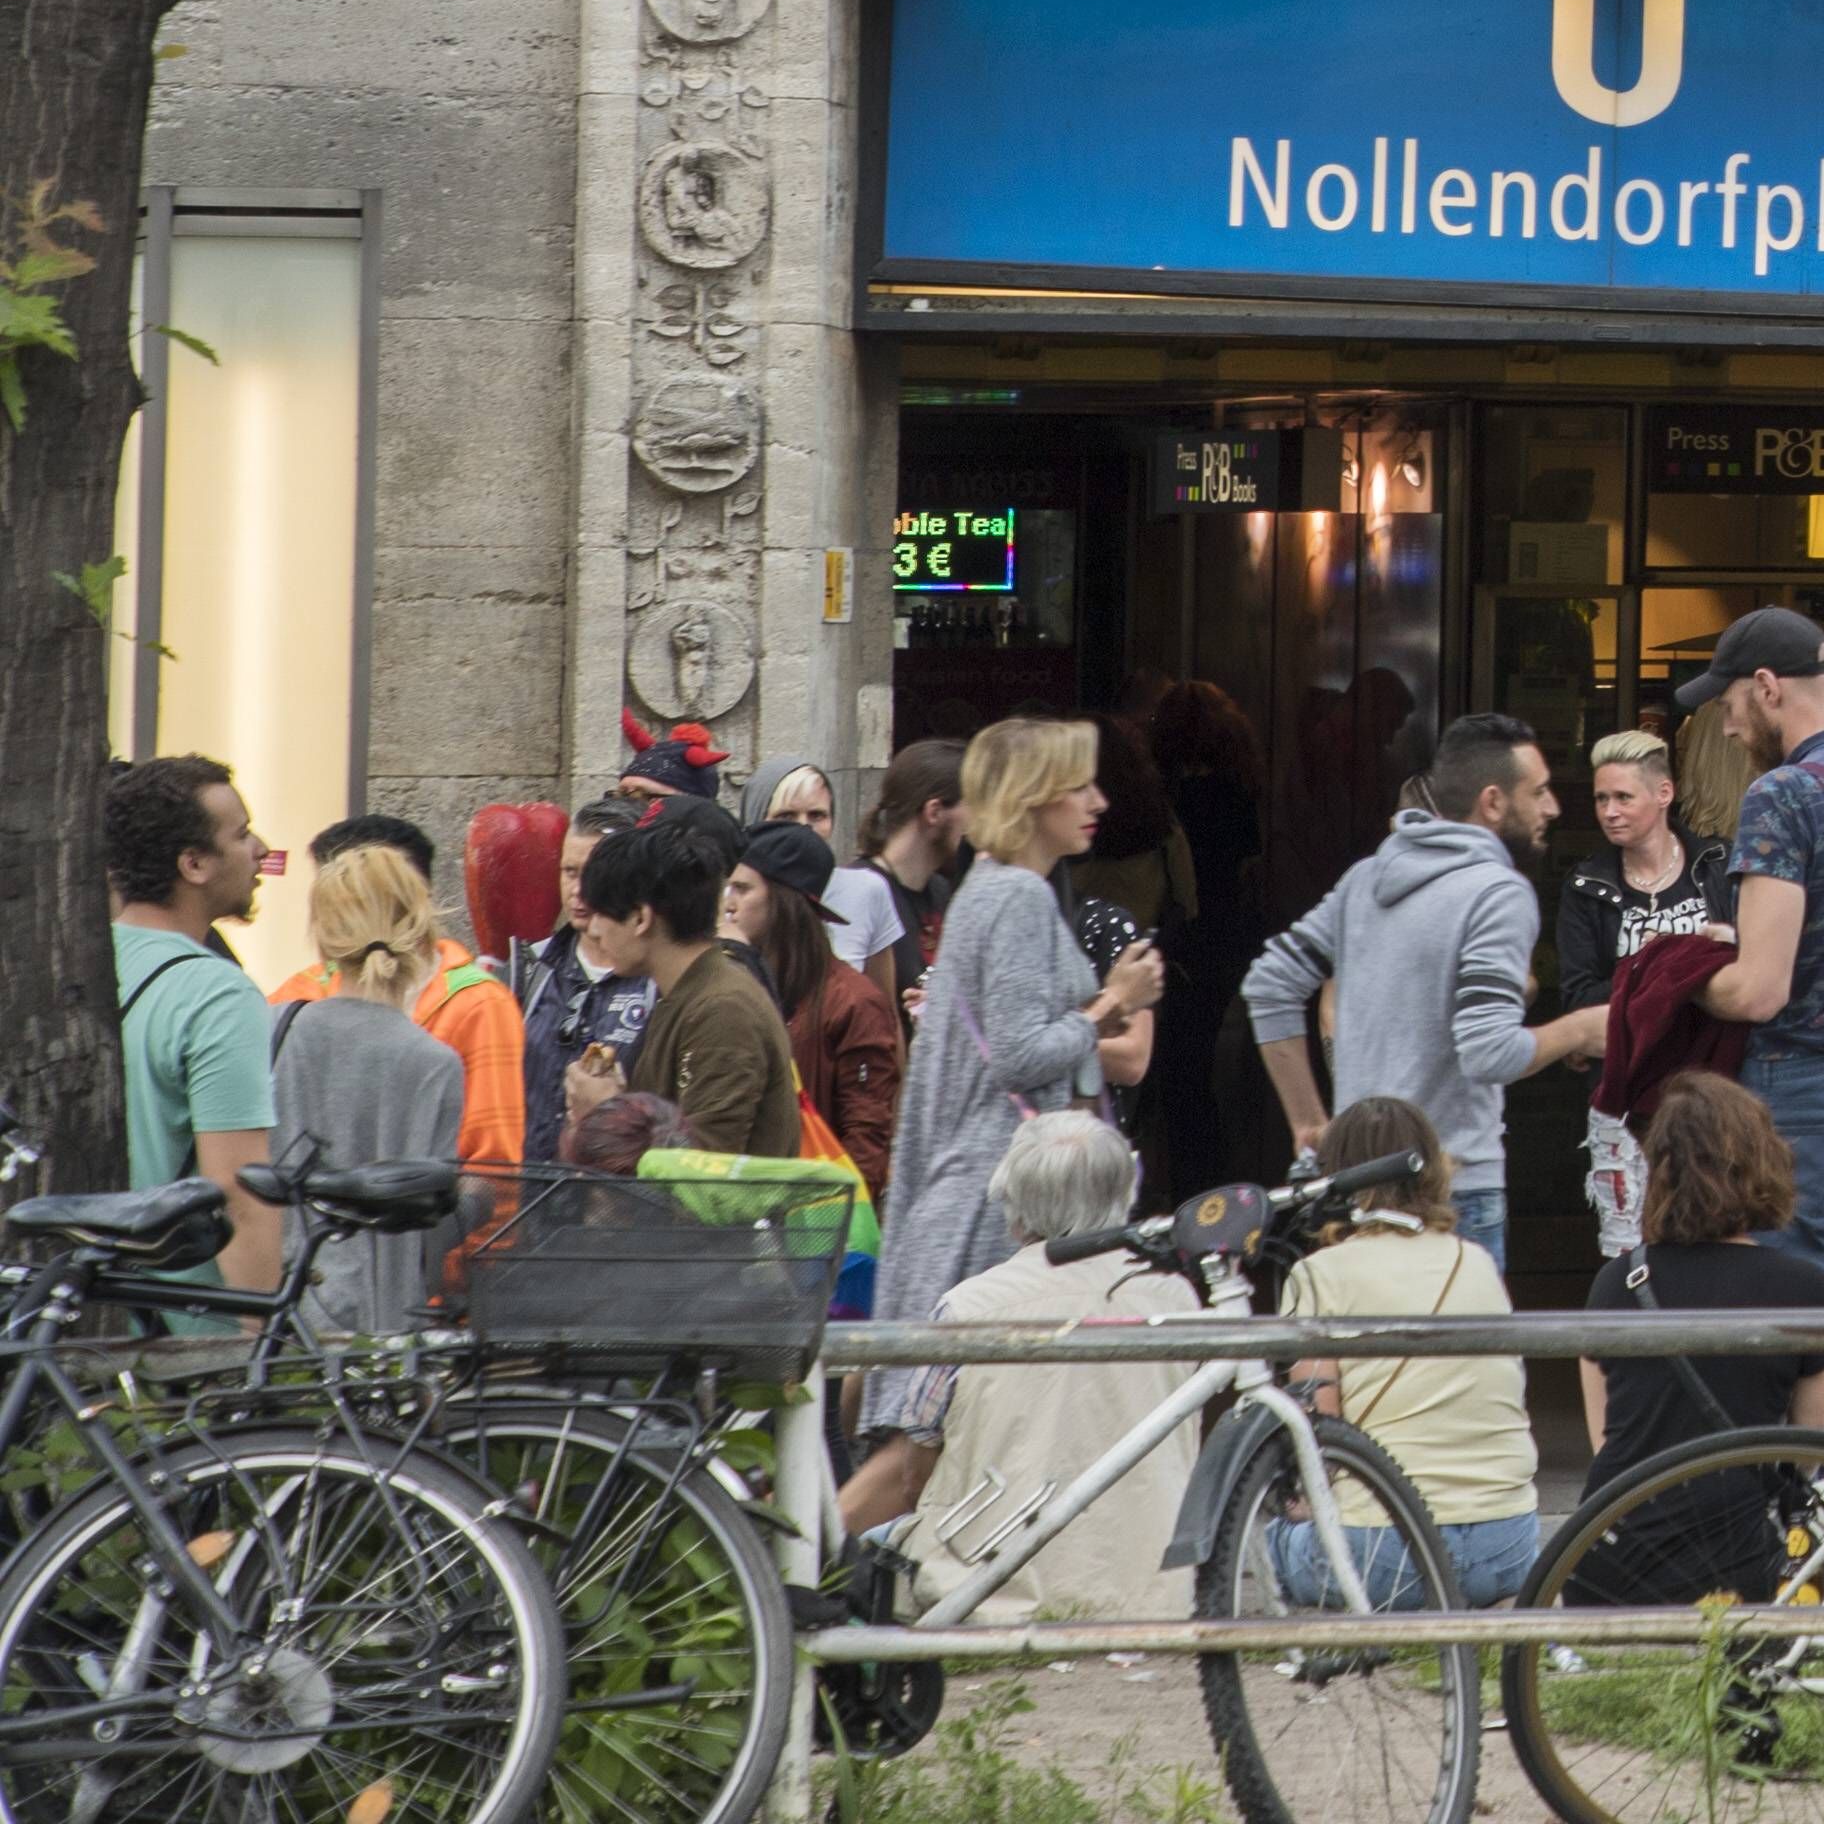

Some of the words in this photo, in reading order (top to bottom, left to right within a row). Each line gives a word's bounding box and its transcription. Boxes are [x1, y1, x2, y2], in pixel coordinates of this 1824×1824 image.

[1667, 427, 1730, 451] Press
[1177, 443, 1197, 470] Press
[1231, 475, 1256, 503] Books
[953, 512, 1007, 536] Tea
[892, 542, 918, 577] 3
[926, 542, 952, 577] €
